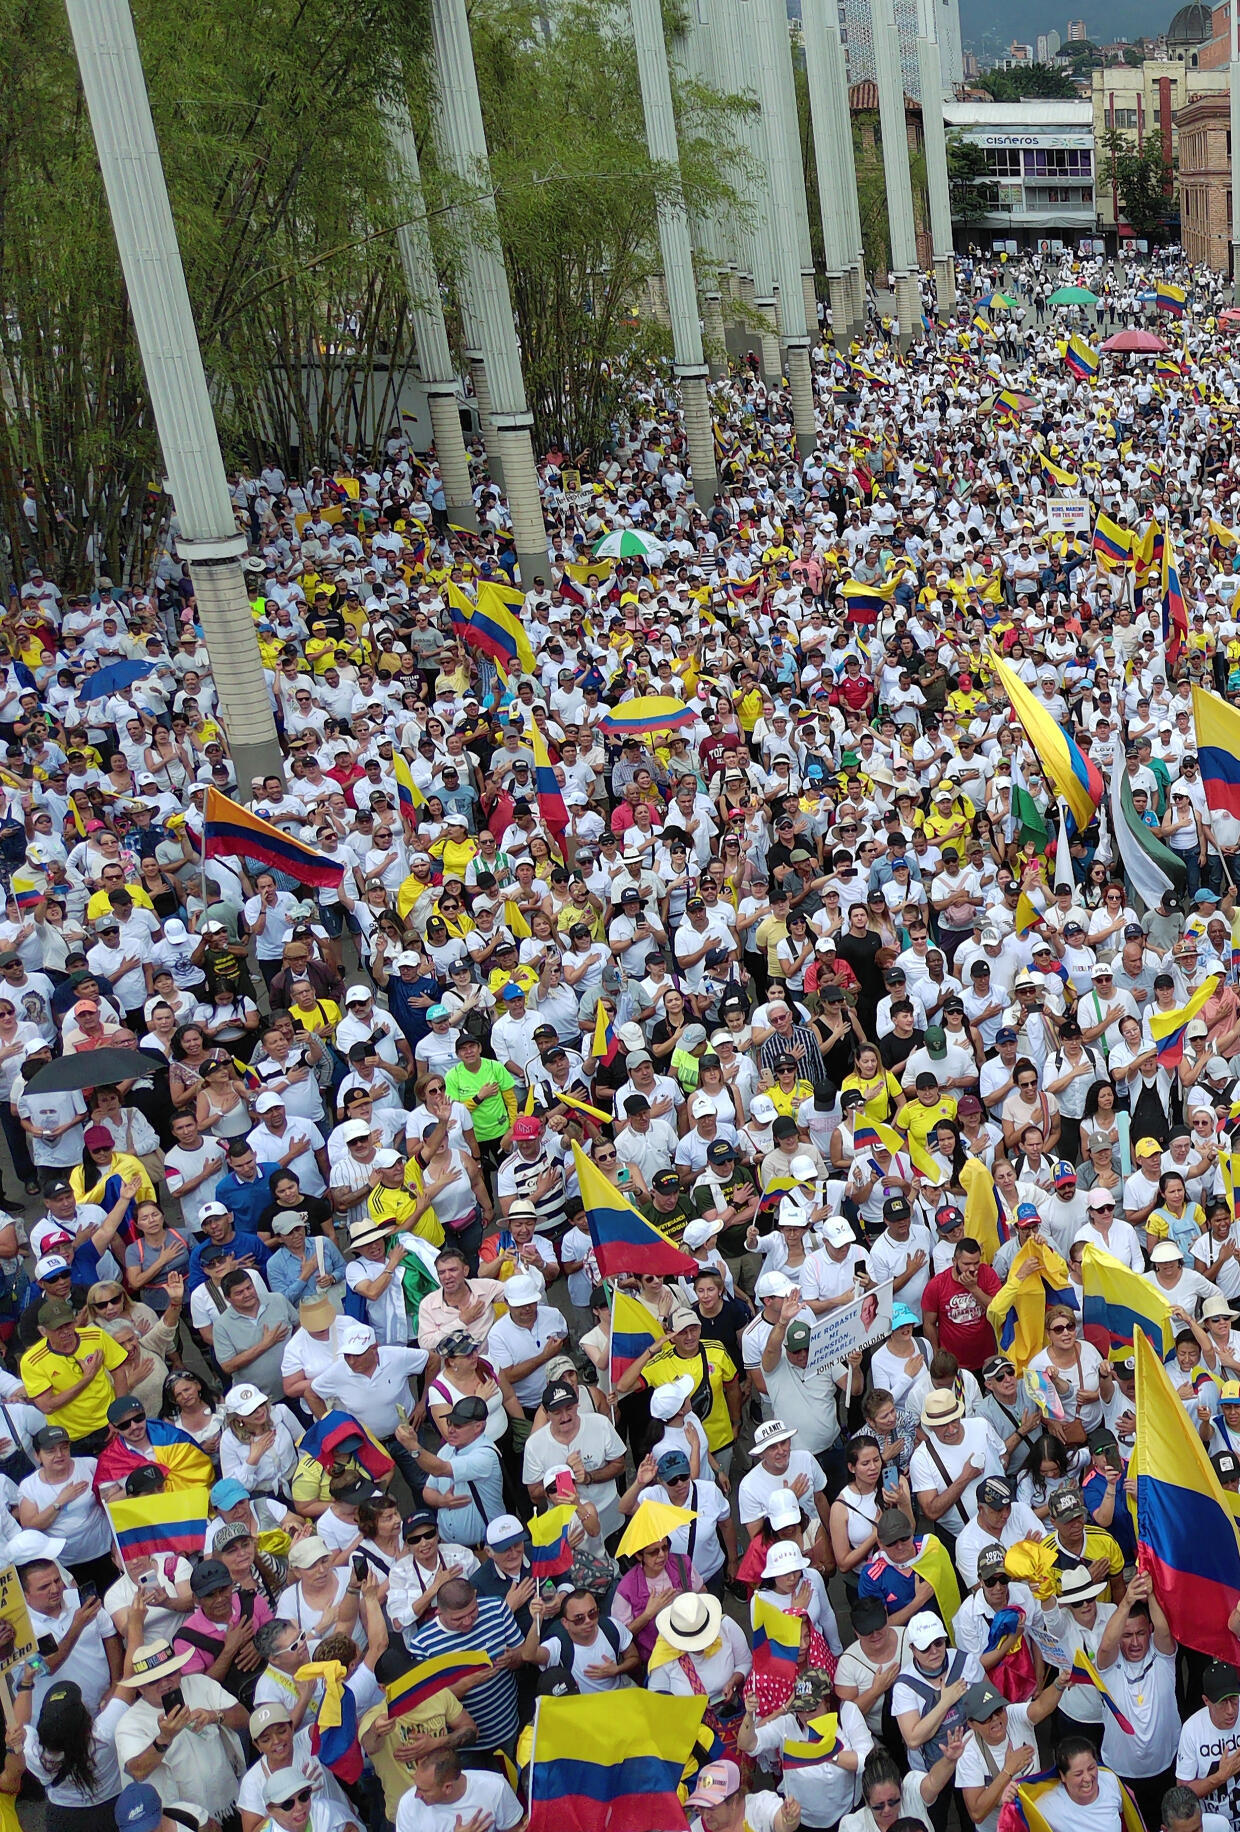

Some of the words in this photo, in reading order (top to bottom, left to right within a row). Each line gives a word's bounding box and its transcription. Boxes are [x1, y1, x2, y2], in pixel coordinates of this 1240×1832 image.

[986, 134, 1039, 145] cisneros
[810, 1332, 822, 1343] ME
[823, 1309, 858, 1335] ROBASTE
[829, 1329, 839, 1341] MI
[762, 1422, 783, 1438] PLANET
